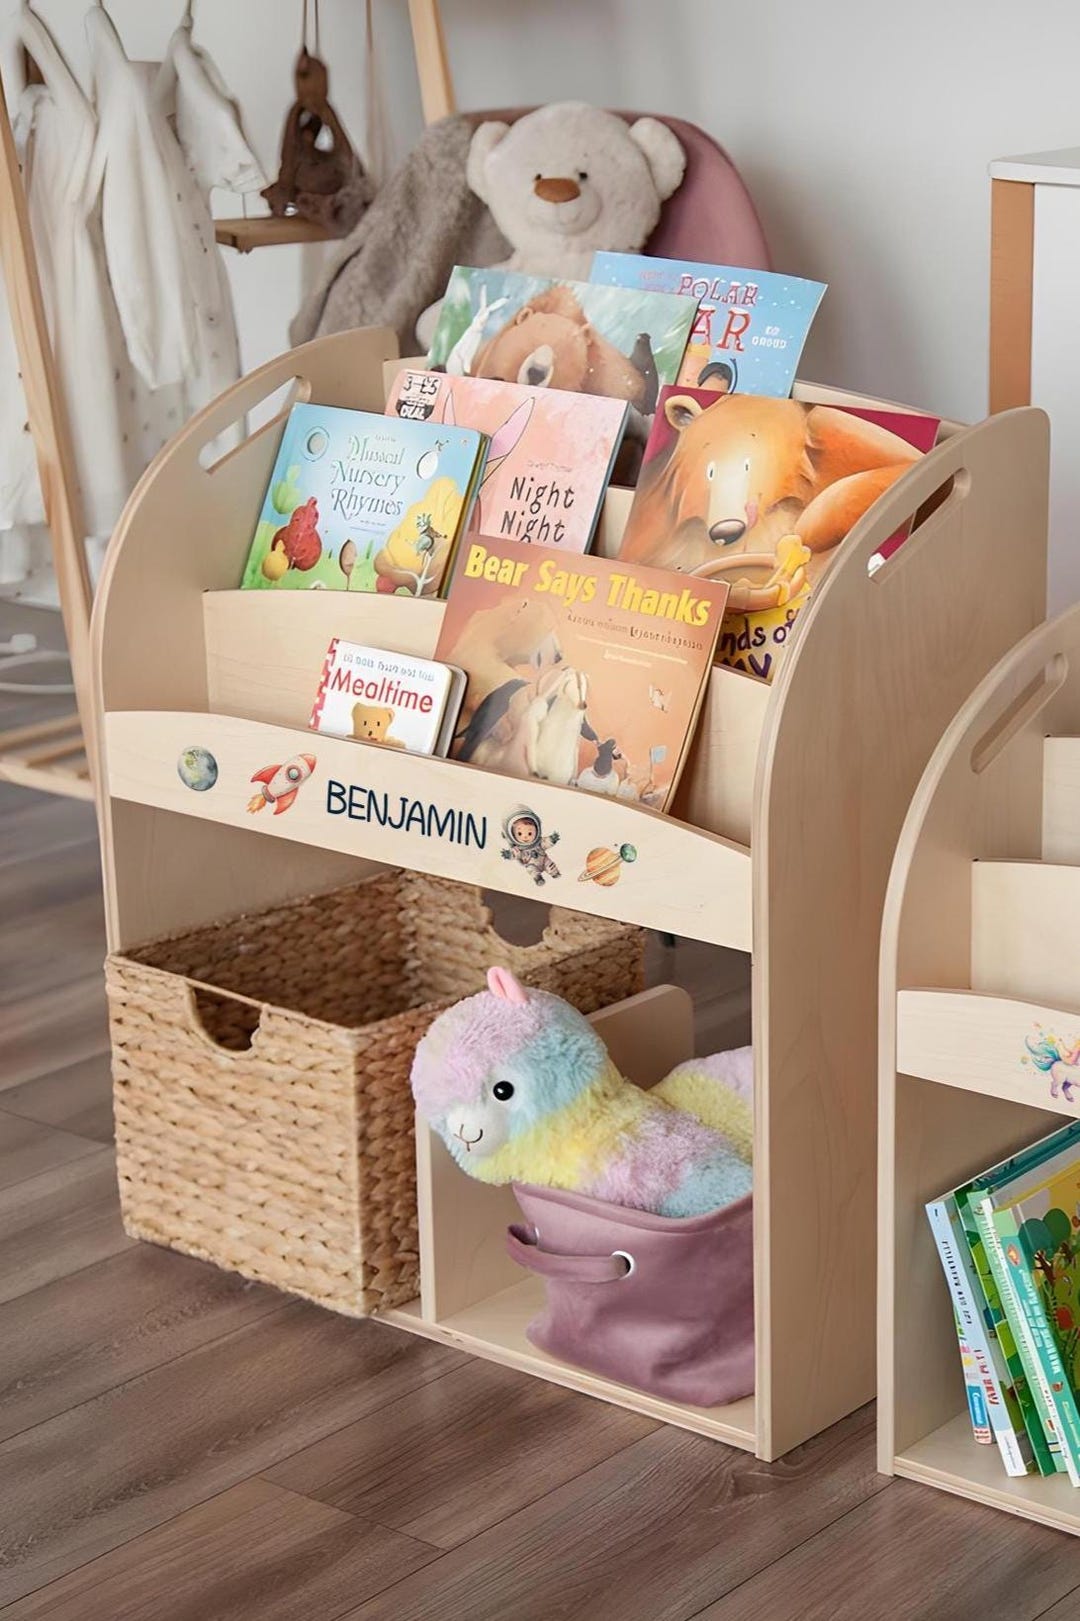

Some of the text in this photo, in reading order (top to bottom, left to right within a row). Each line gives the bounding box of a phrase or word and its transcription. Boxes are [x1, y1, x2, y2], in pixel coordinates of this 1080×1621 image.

[690, 304, 751, 351] AR
[330, 460, 406, 496] Nursery
[510, 477, 575, 514] Night
[331, 487, 404, 520] Rhymes
[500, 511, 565, 543] Night
[464, 545, 712, 626] Bear Says Thanks
[720, 616, 767, 657] nds
[330, 667, 433, 713] Mealtime
[326, 779, 487, 850] BENJAMIN
